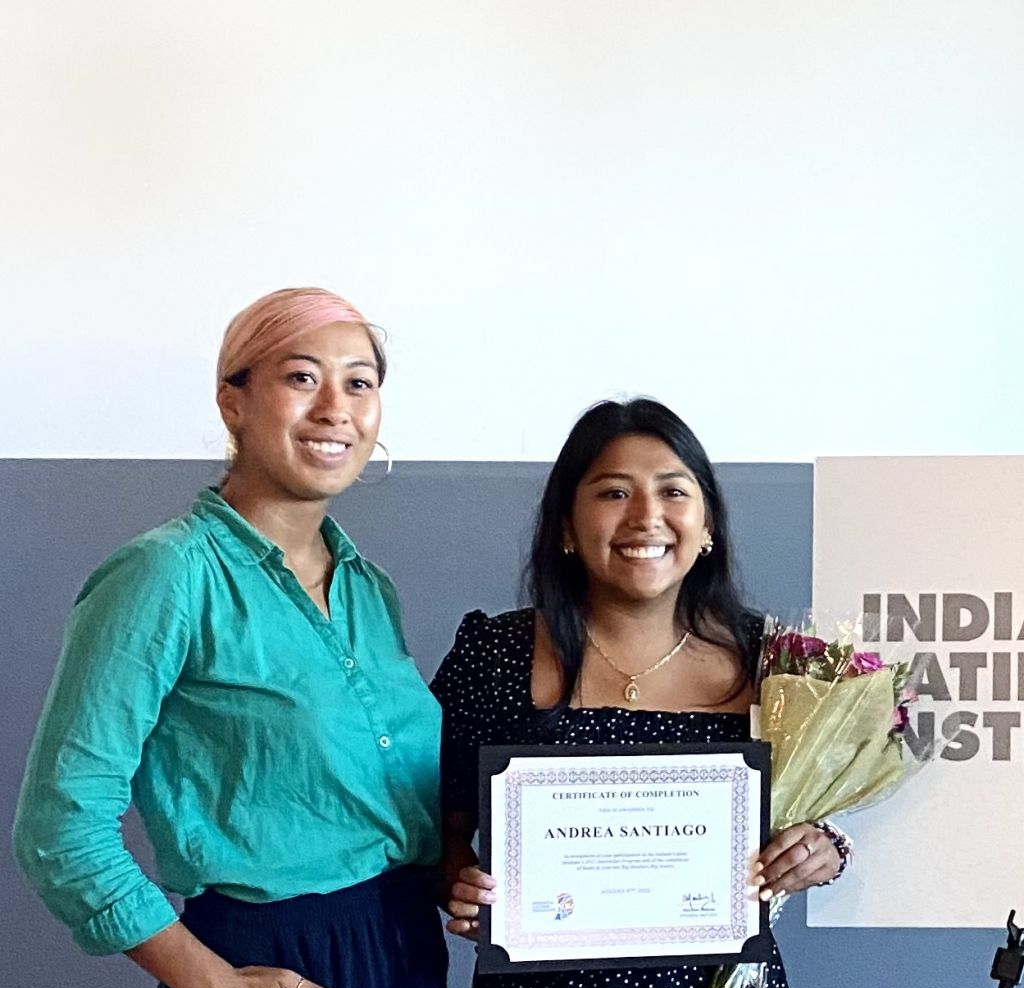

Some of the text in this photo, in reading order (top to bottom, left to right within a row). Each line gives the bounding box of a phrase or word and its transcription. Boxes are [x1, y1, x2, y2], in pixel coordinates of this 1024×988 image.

[552, 789, 700, 800] CERTIFICATE OF COMPLETION
[544, 824, 707, 839] ANDREA SANTIAGO
